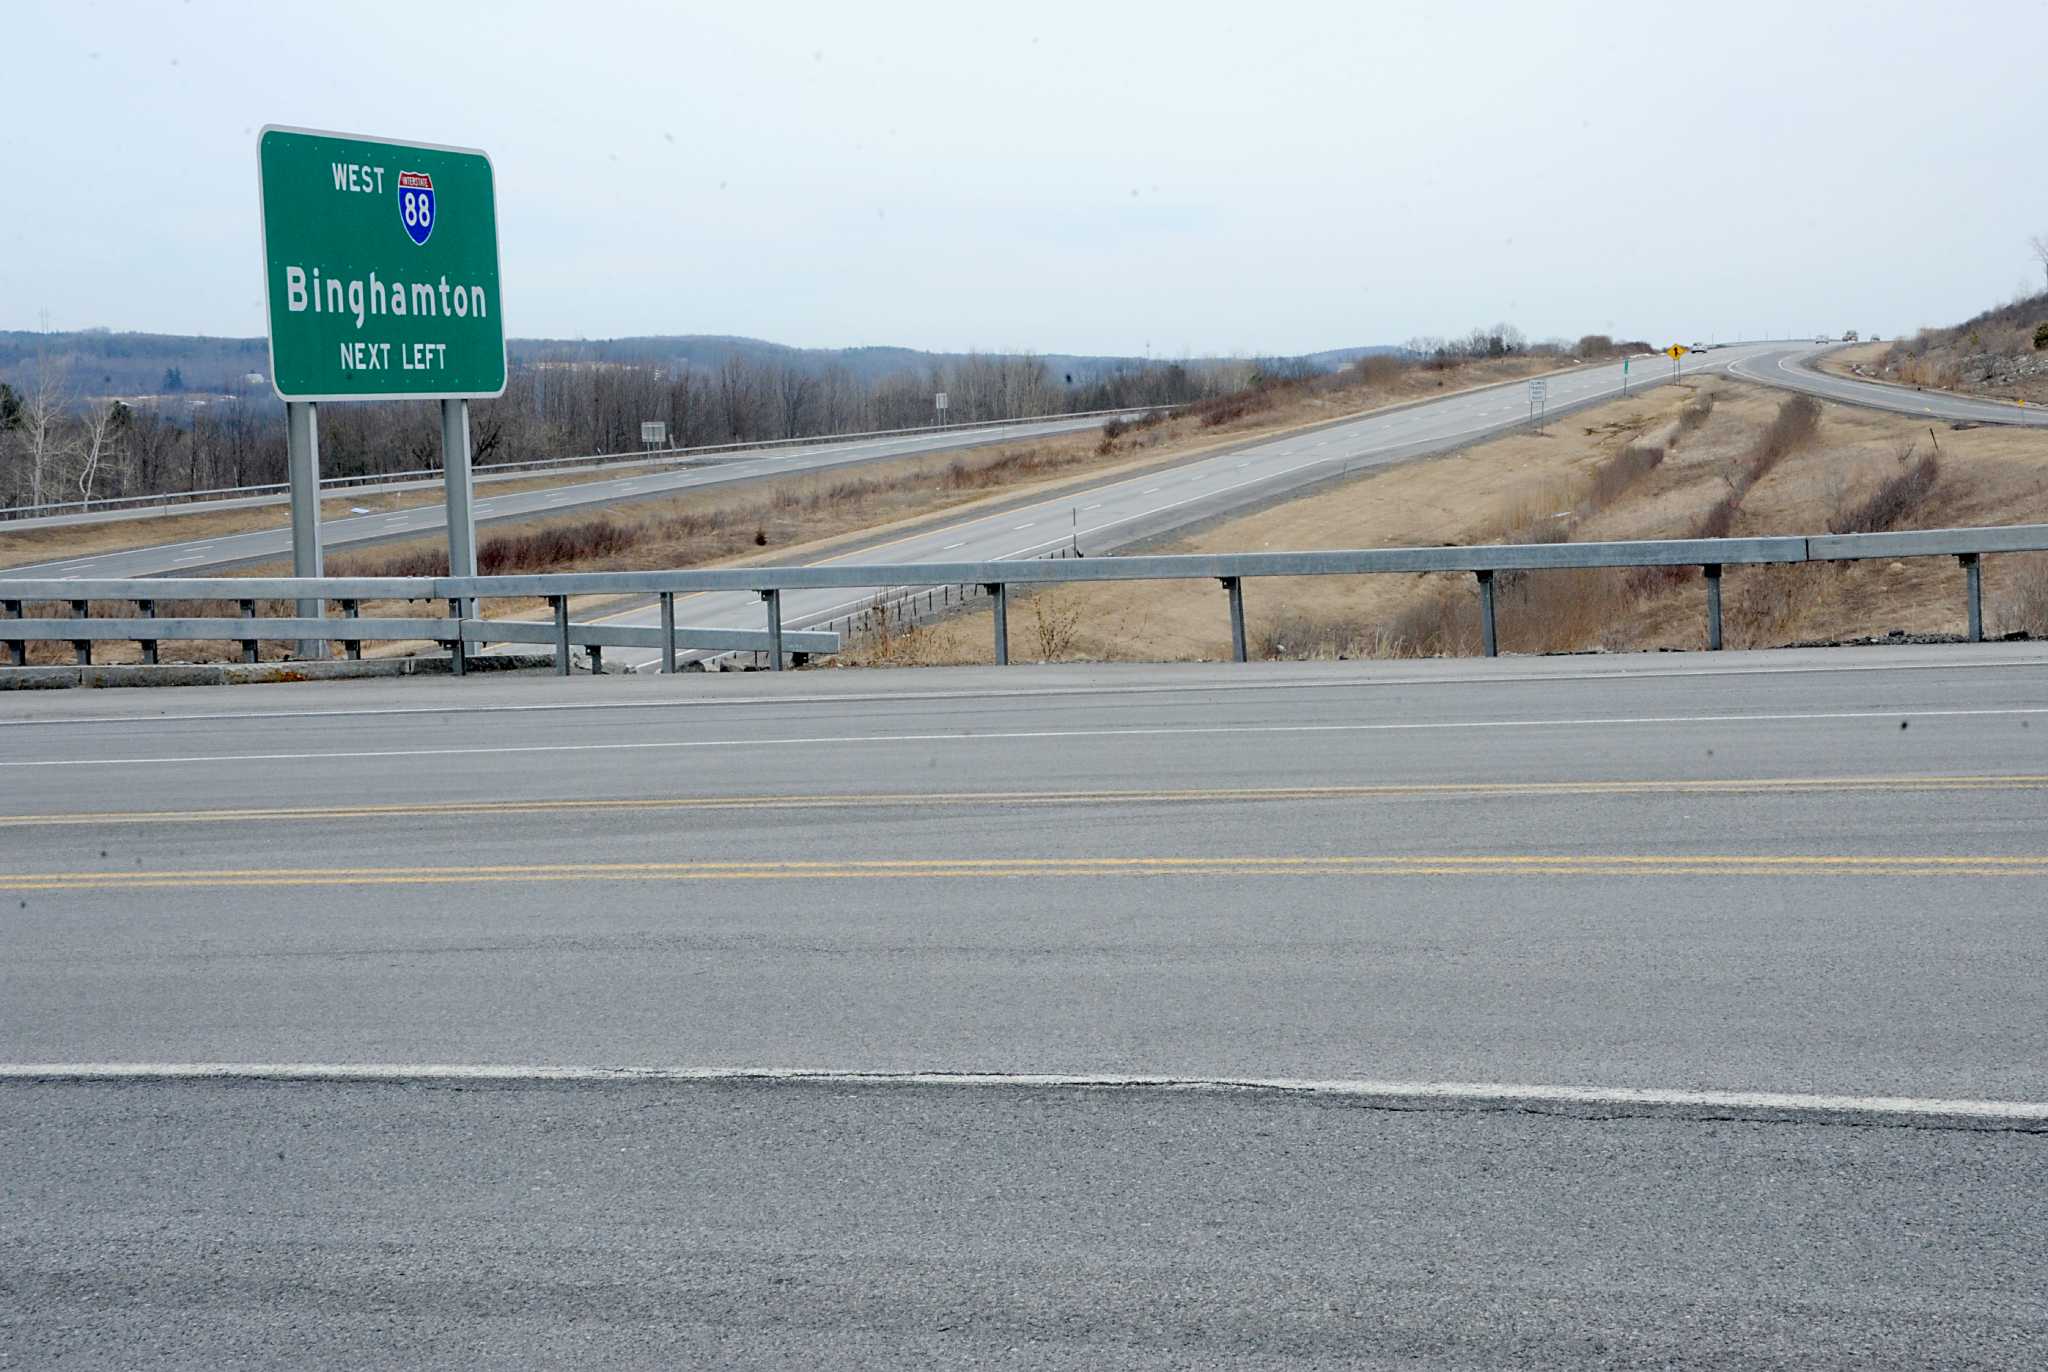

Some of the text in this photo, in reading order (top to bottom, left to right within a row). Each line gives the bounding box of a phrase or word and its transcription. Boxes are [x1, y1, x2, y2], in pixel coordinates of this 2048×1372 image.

[332, 162, 384, 194] WEST
[405, 192, 430, 227] 88
[286, 266, 486, 329] Binghamton
[340, 342, 446, 370] NEXT LEFT
